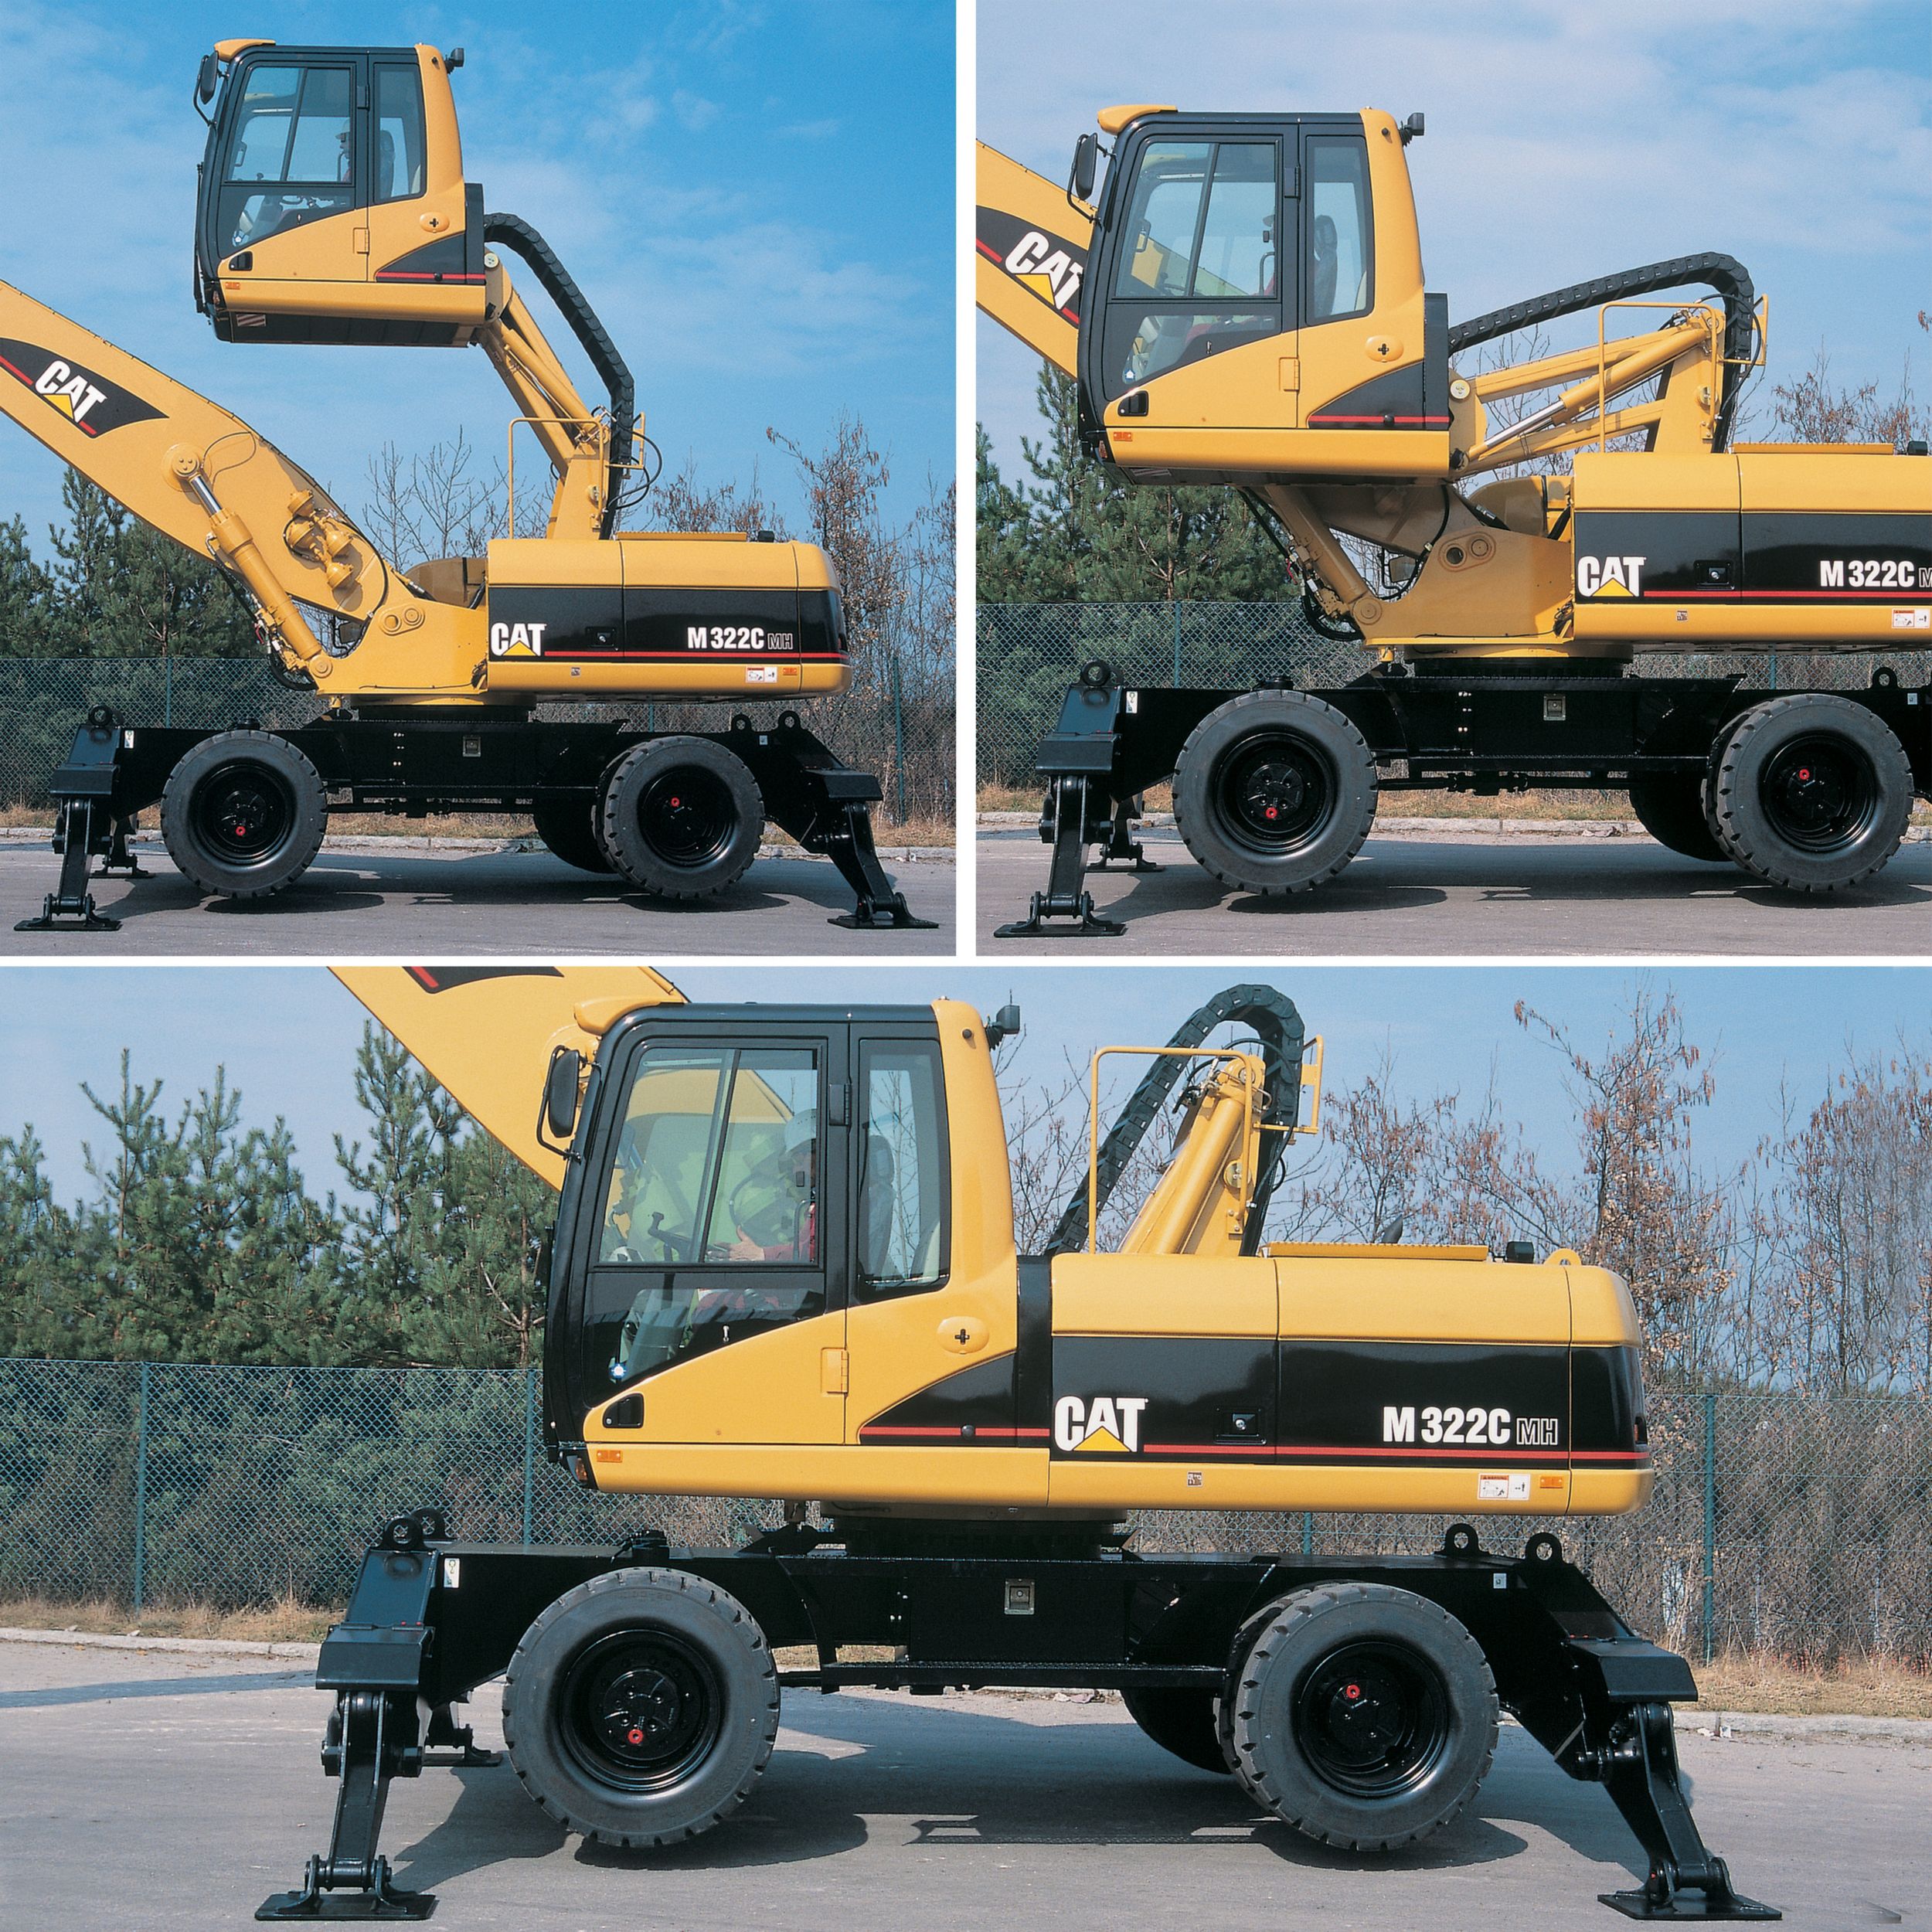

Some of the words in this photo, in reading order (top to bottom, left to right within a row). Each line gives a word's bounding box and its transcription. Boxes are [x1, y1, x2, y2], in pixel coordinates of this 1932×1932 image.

[35, 360, 108, 423] CAT
[1577, 556, 1647, 597] CAT
[491, 622, 547, 656] CAT
[767, 633, 793, 650] MH
[1054, 1396, 1149, 1452] CAT
[1516, 1417, 1558, 1445] MH
